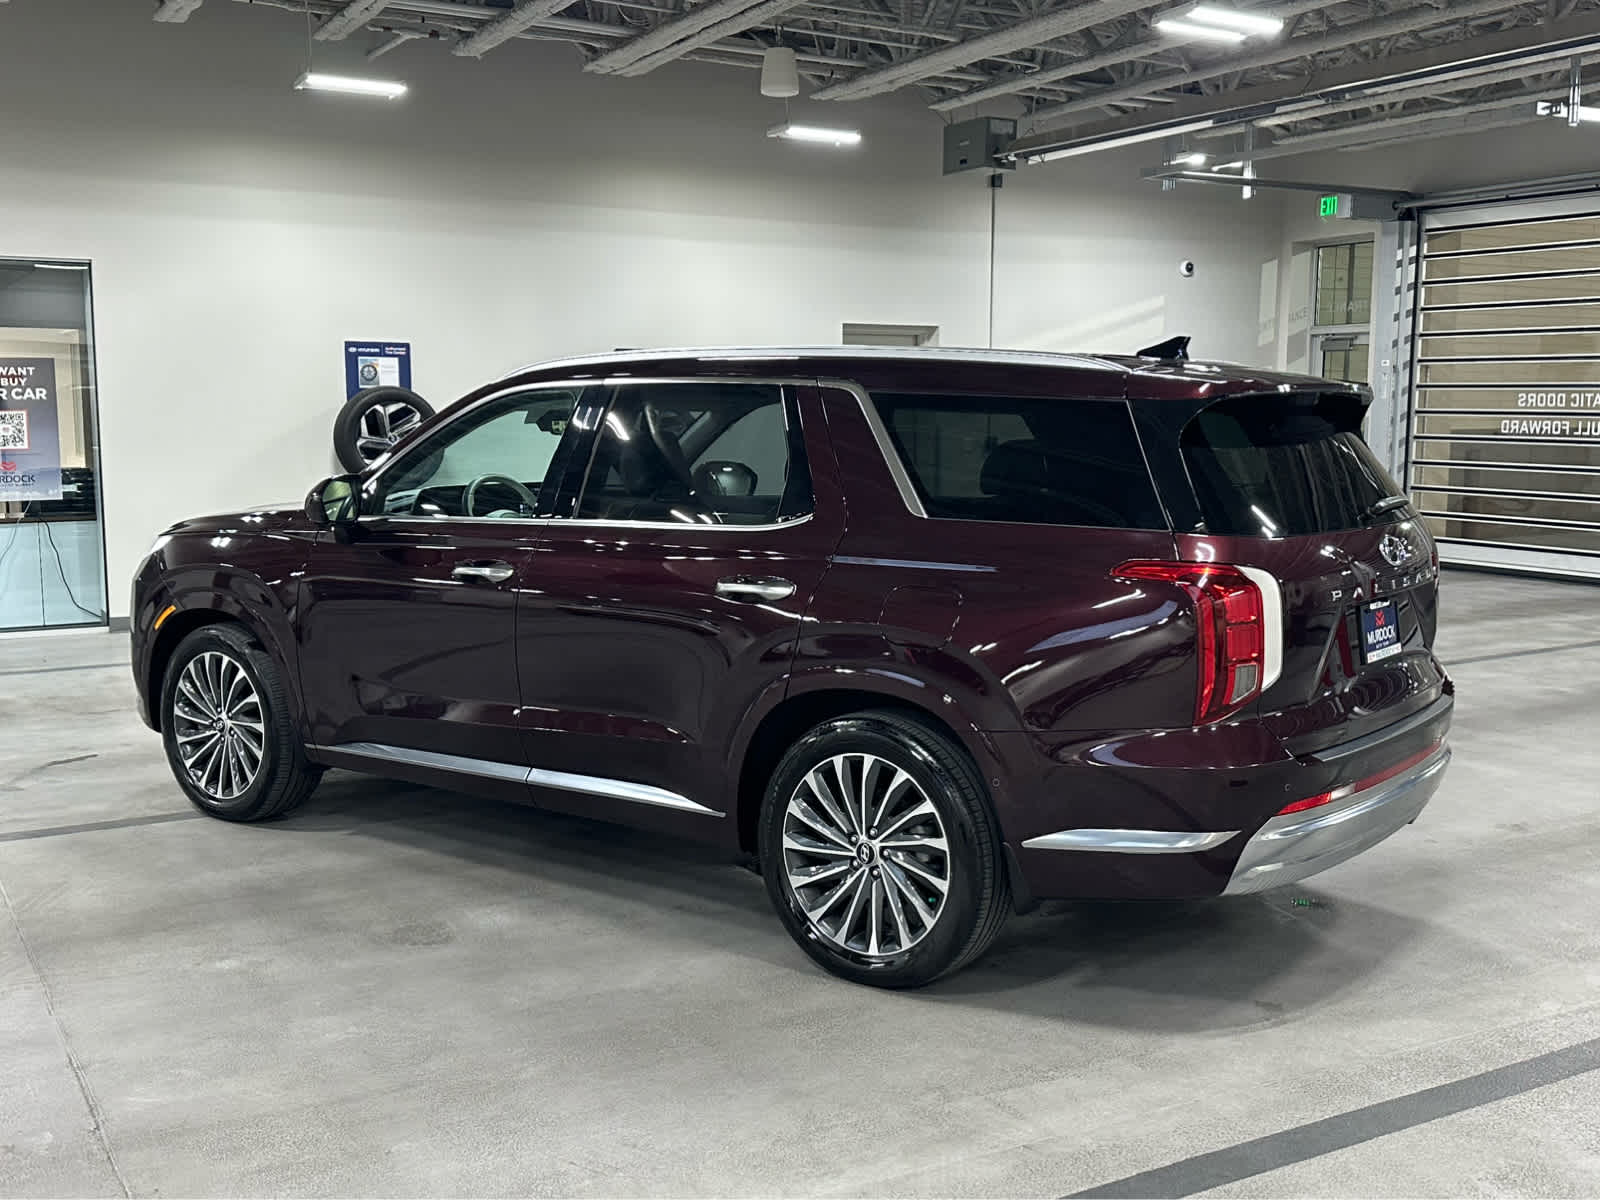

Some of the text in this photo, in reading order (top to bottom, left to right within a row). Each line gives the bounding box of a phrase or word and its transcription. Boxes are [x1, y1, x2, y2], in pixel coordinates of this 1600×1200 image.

[1320, 196, 1338, 216] EXIT
[0, 377, 27, 386] BUY
[11, 387, 47, 400] CAR
[1367, 625, 1396, 644] MURDOCK
